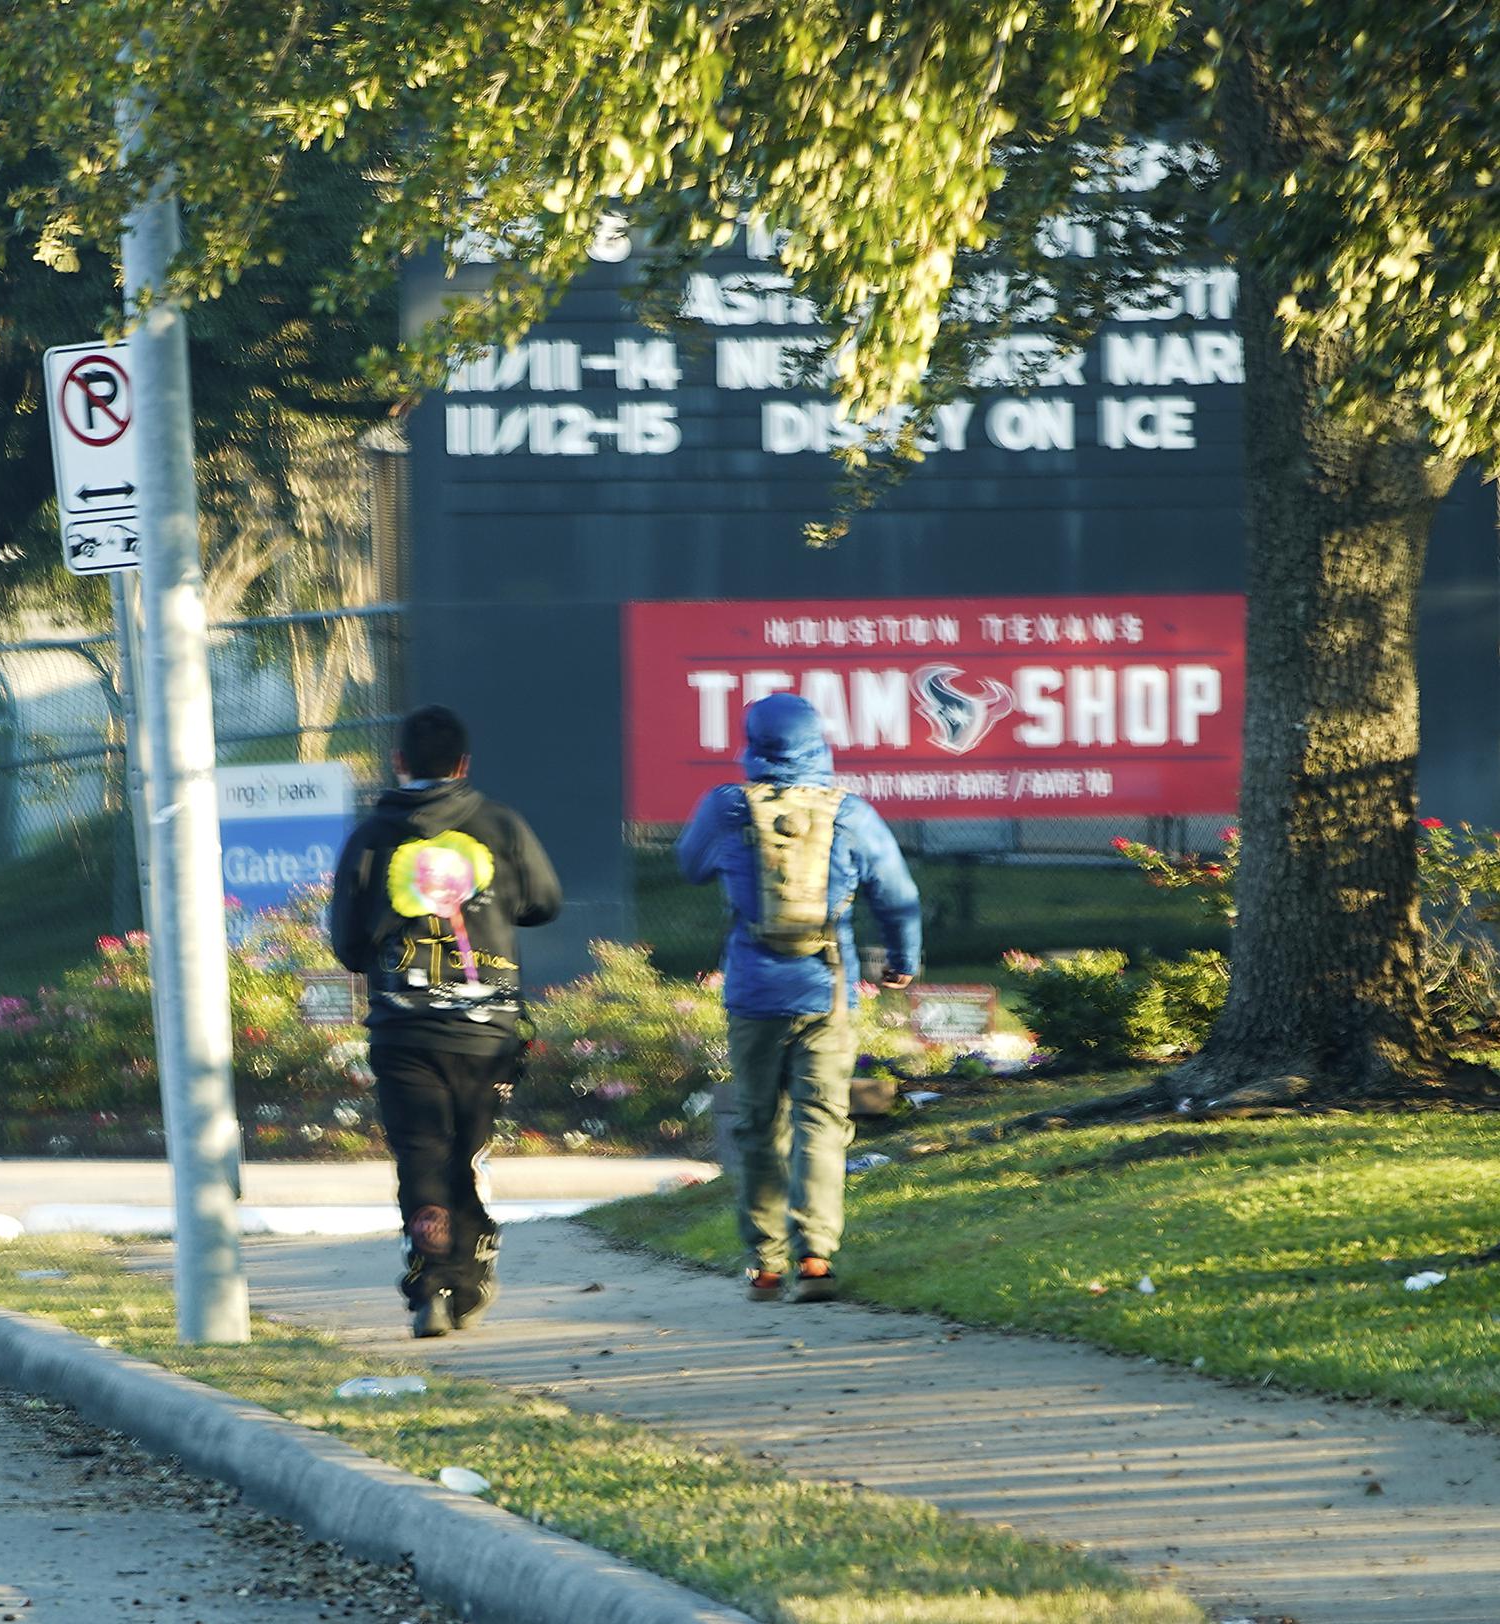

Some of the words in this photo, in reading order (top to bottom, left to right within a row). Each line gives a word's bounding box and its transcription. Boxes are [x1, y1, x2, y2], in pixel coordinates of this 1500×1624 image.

[445, 402, 683, 455] 11/12-15
[985, 397, 1075, 451] ON
[1098, 395, 1198, 450] ICE
[763, 614, 960, 648] HOUSTON
[978, 612, 1144, 645] TEXANS
[1012, 663, 1222, 748] SHOP
[225, 784, 255, 808] nrg
[897, 771, 950, 801] NEXT
[955, 769, 1009, 800] GATE
[1031, 768, 1084, 799] GATE
[224, 846, 300, 884] Gate
